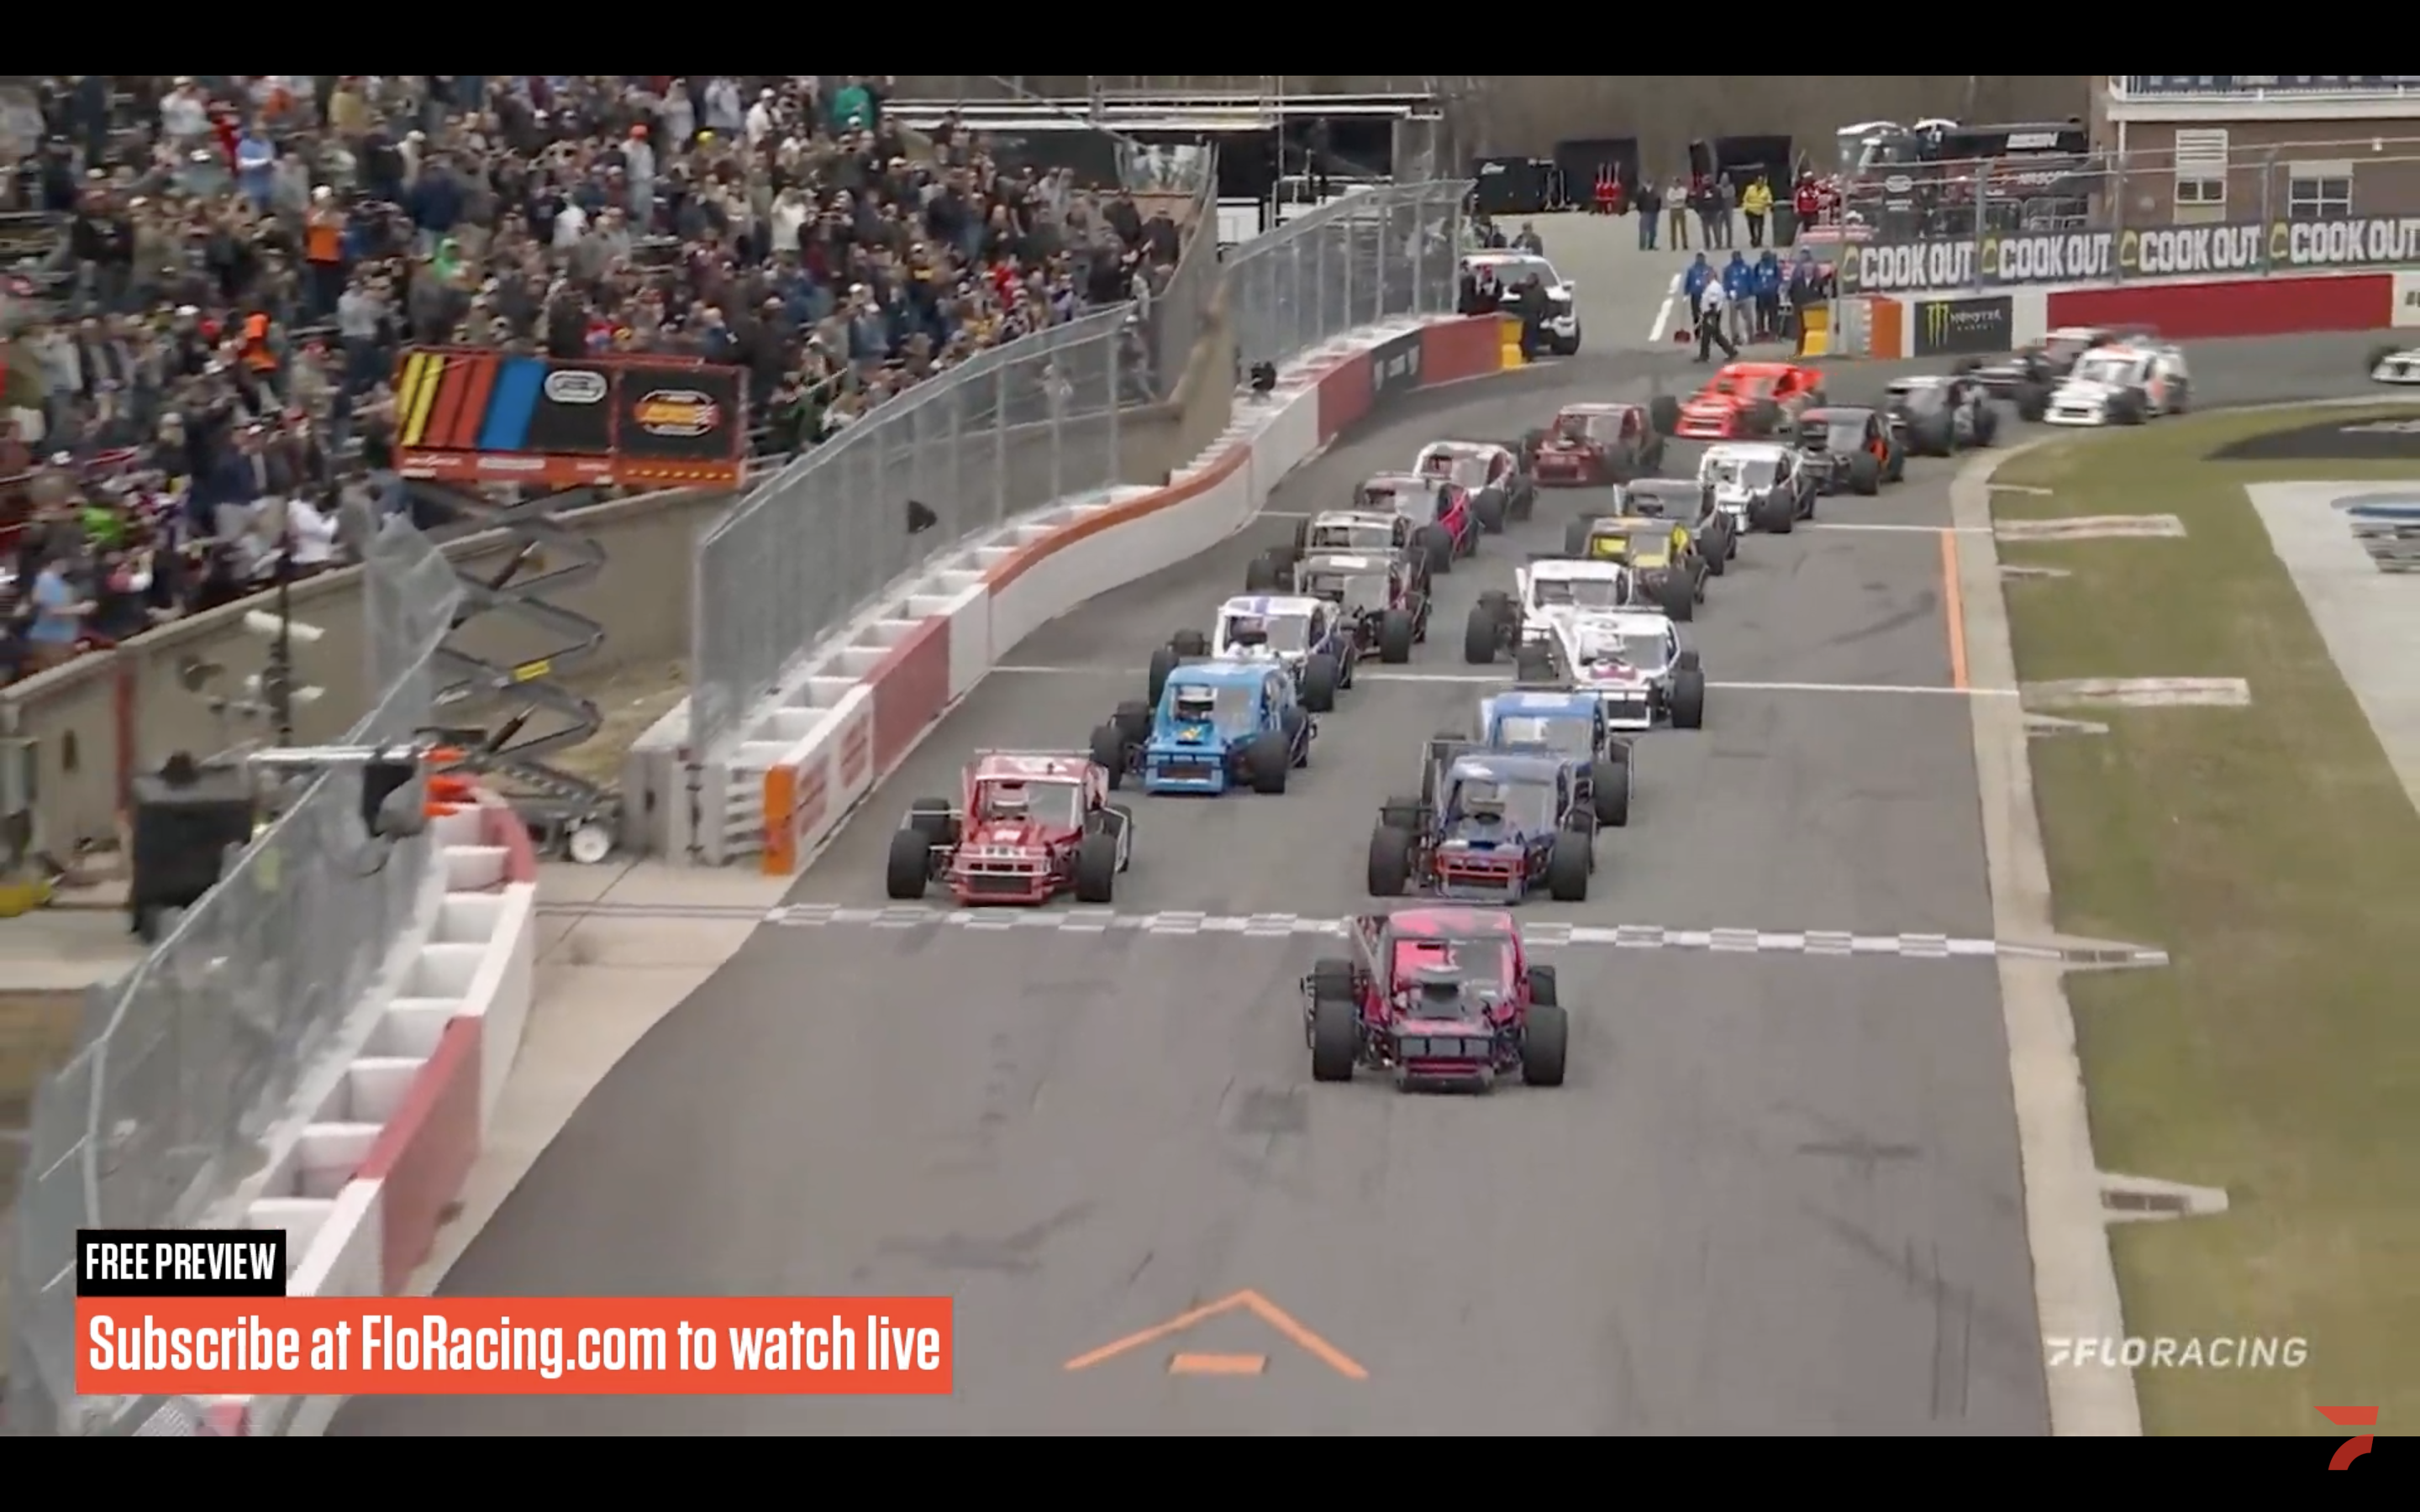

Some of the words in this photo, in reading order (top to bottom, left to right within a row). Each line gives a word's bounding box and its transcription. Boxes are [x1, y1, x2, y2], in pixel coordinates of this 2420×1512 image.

[1998, 235, 2066, 279] COOK
[2066, 234, 2112, 276] OUT
[2139, 228, 2211, 272] COOK
[2212, 224, 2262, 269] OUT
[2290, 219, 2367, 264] COOK
[2367, 217, 2420, 260] OUT
[1860, 243, 1928, 288] COOK
[1929, 241, 1975, 286] OUT
